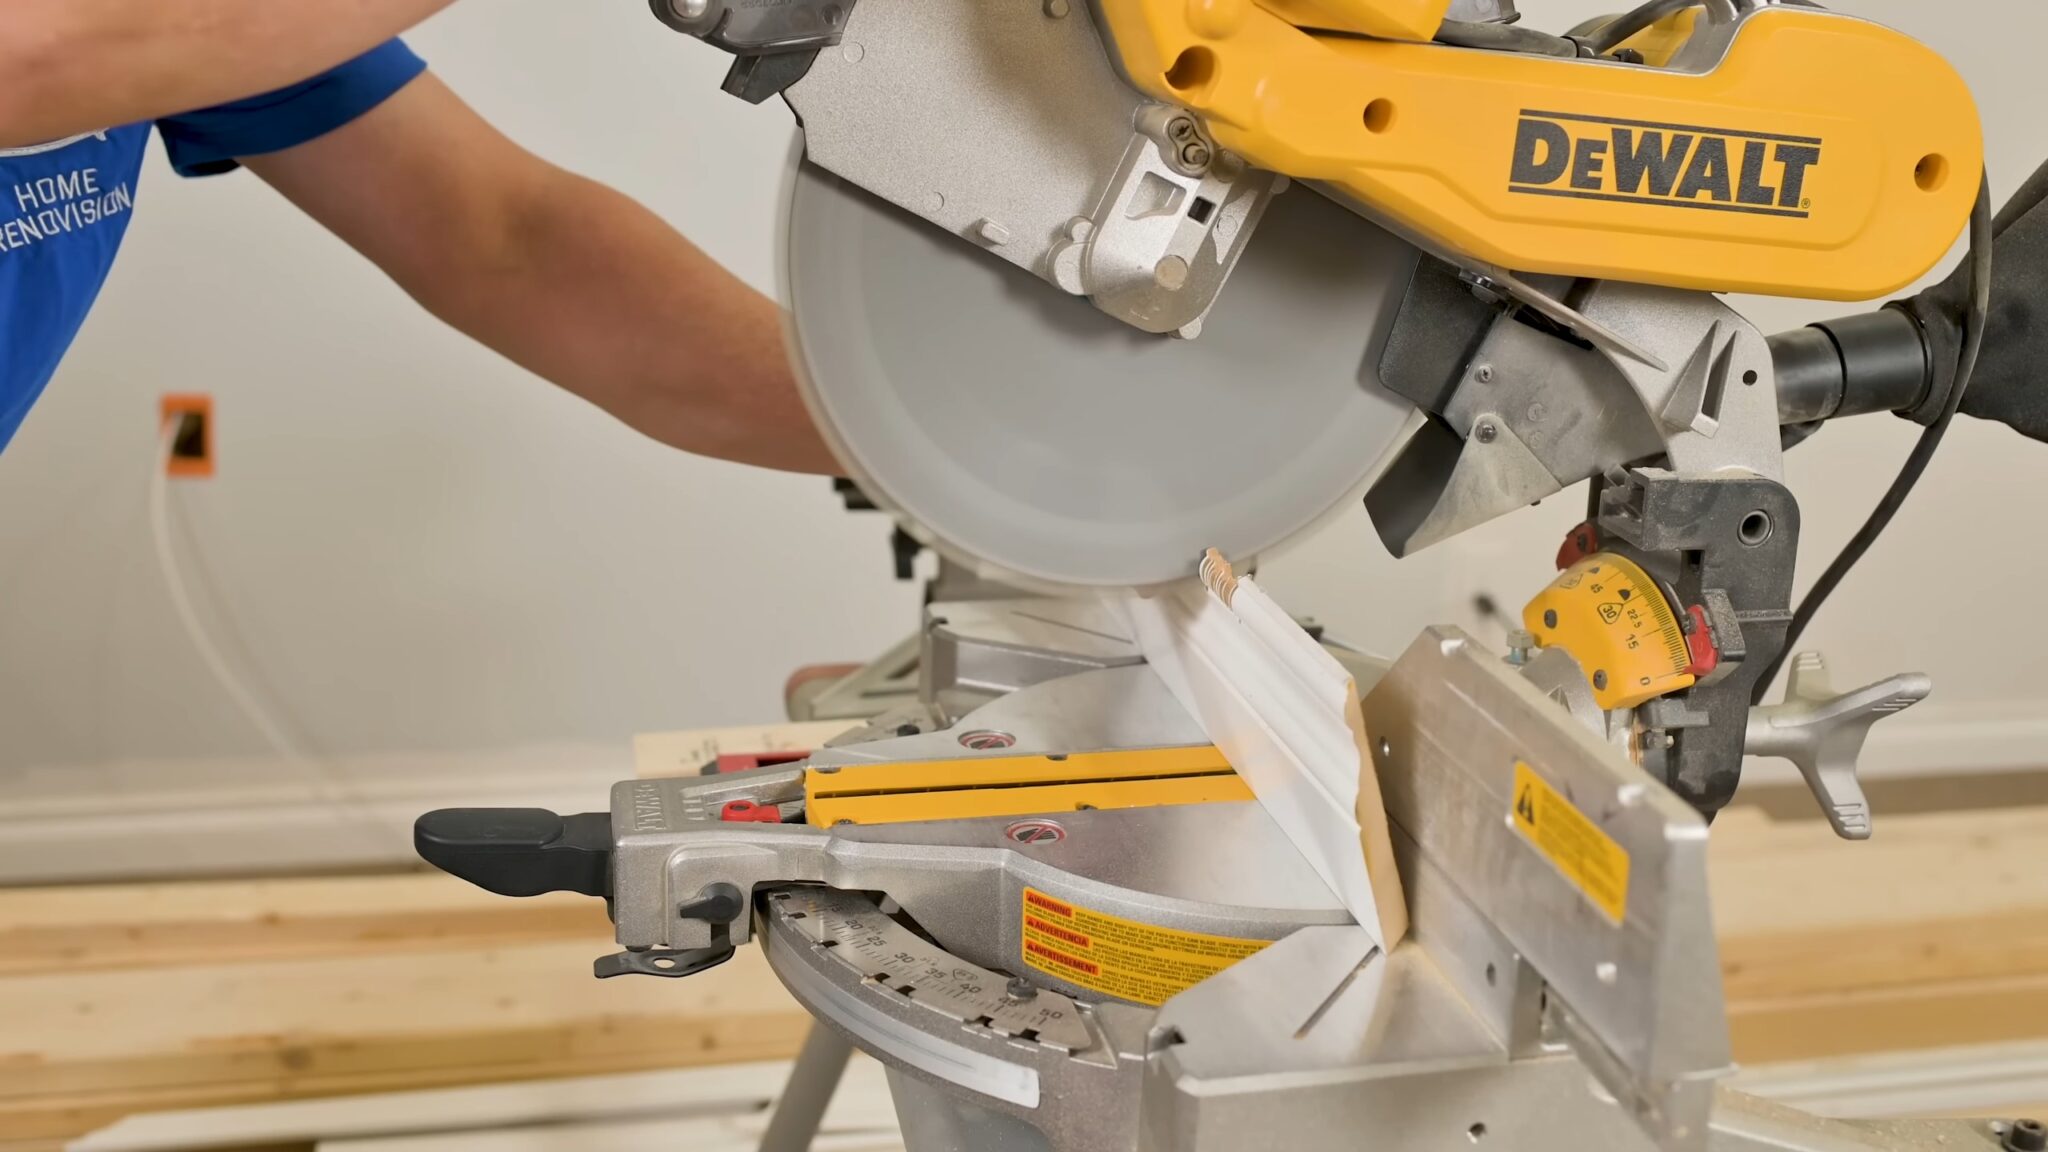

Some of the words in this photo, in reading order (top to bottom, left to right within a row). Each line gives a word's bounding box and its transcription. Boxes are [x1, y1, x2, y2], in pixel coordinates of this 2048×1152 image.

[14, 168, 99, 212] HOME
[1590, 583, 1603, 594] 45
[1602, 604, 1617, 619] 30
[1626, 608, 1642, 629] 22.5
[1625, 633, 1639, 650] 15
[1639, 676, 1651, 686] 0
[1034, 894, 1071, 917] WARNING
[844, 919, 863, 930] 20
[1035, 920, 1088, 947] ADVERTENCIA
[866, 935, 887, 947] 25
[894, 952, 915, 963] 30
[1034, 944, 1097, 974] AVERTISSEMENT
[924, 967, 947, 979] 35
[959, 983, 982, 993] 40
[1039, 1008, 1063, 1019] 50
